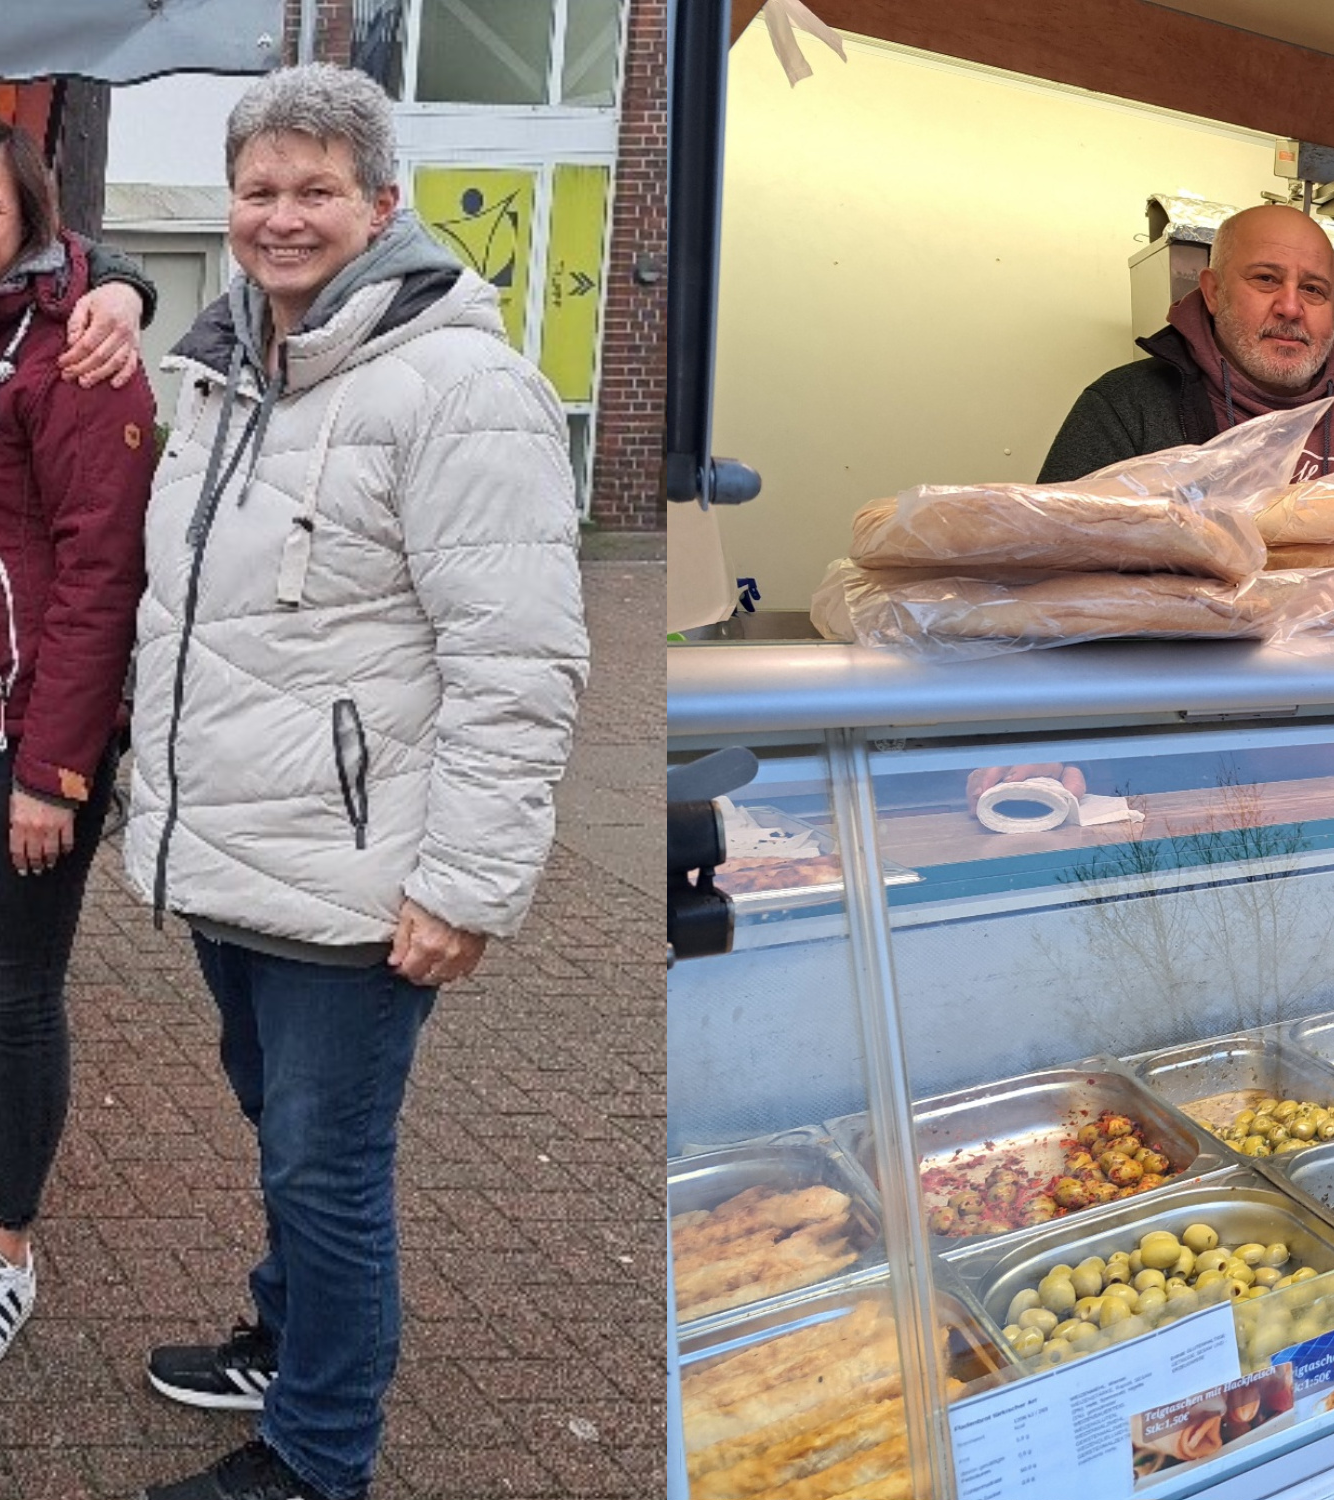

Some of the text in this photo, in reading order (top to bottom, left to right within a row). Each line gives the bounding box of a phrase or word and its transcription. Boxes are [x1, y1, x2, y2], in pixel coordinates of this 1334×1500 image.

[1144, 1365, 1277, 1421] Teigtaschen mit Hackfleisch
